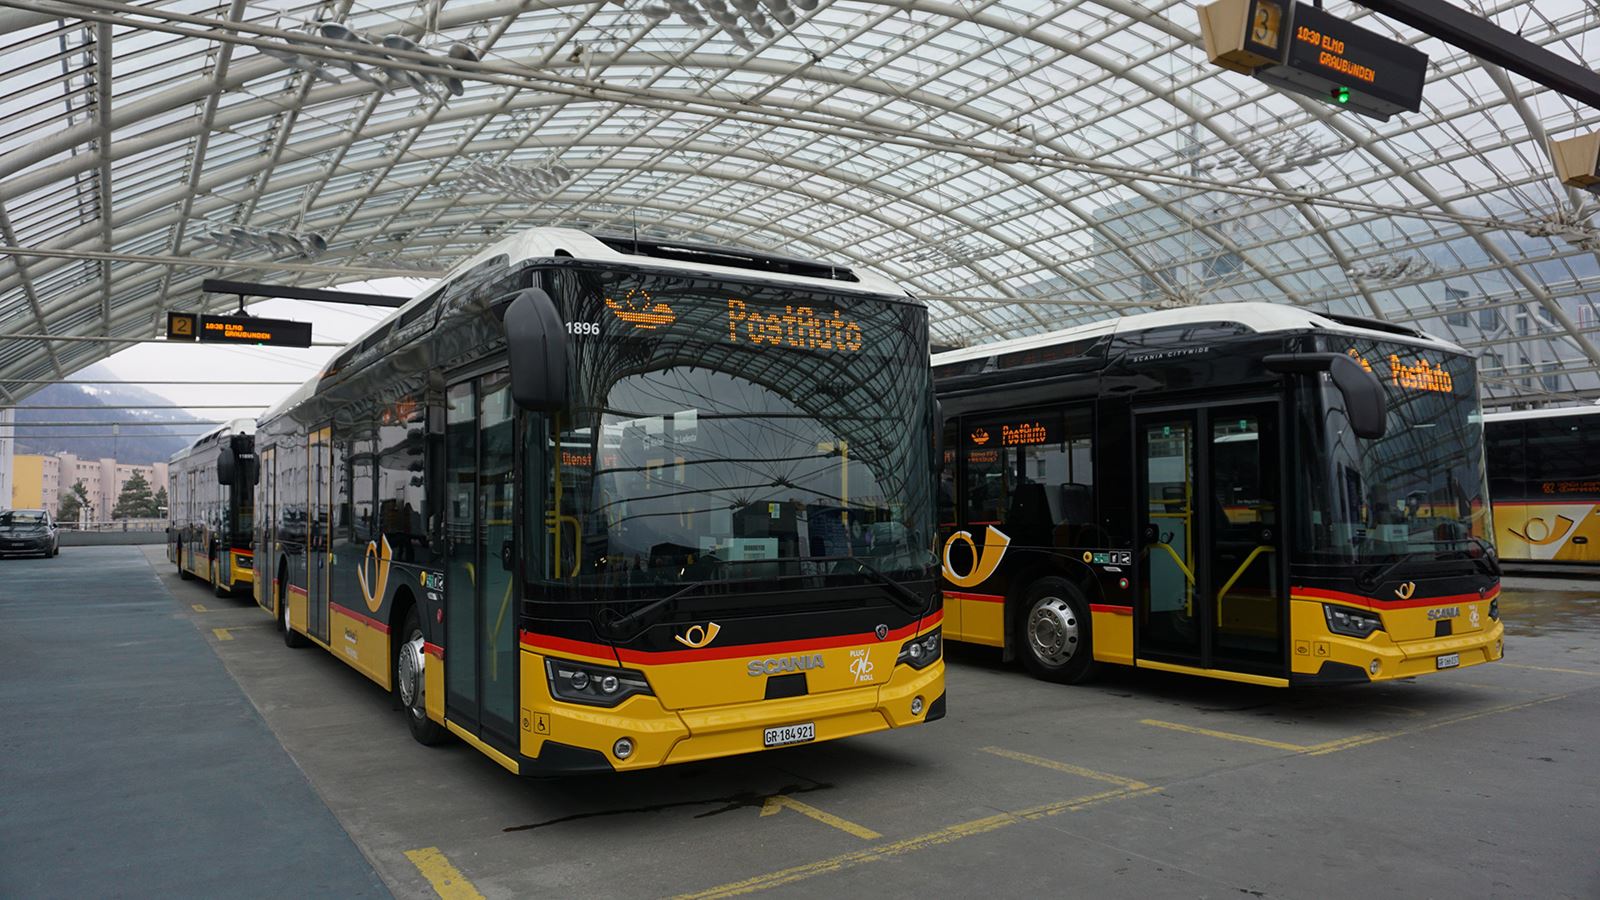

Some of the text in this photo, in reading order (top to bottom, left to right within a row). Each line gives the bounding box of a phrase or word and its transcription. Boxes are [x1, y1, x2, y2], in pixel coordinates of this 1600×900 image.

[1254, 8, 1269, 40] 3
[1297, 26, 1345, 54] 10:30 ELMO
[177, 319, 187, 332] 2
[565, 321, 600, 336] 1896
[728, 299, 862, 351] PostAuto
[1133, 346, 1210, 363] SCANIA CITYWIDE
[1390, 354, 1453, 393] PostAuto
[1002, 422, 1047, 446] PostAuto
[1427, 607, 1459, 620] SCANIA
[747, 654, 824, 676] SCANIA
[798, 725, 813, 738] 921
